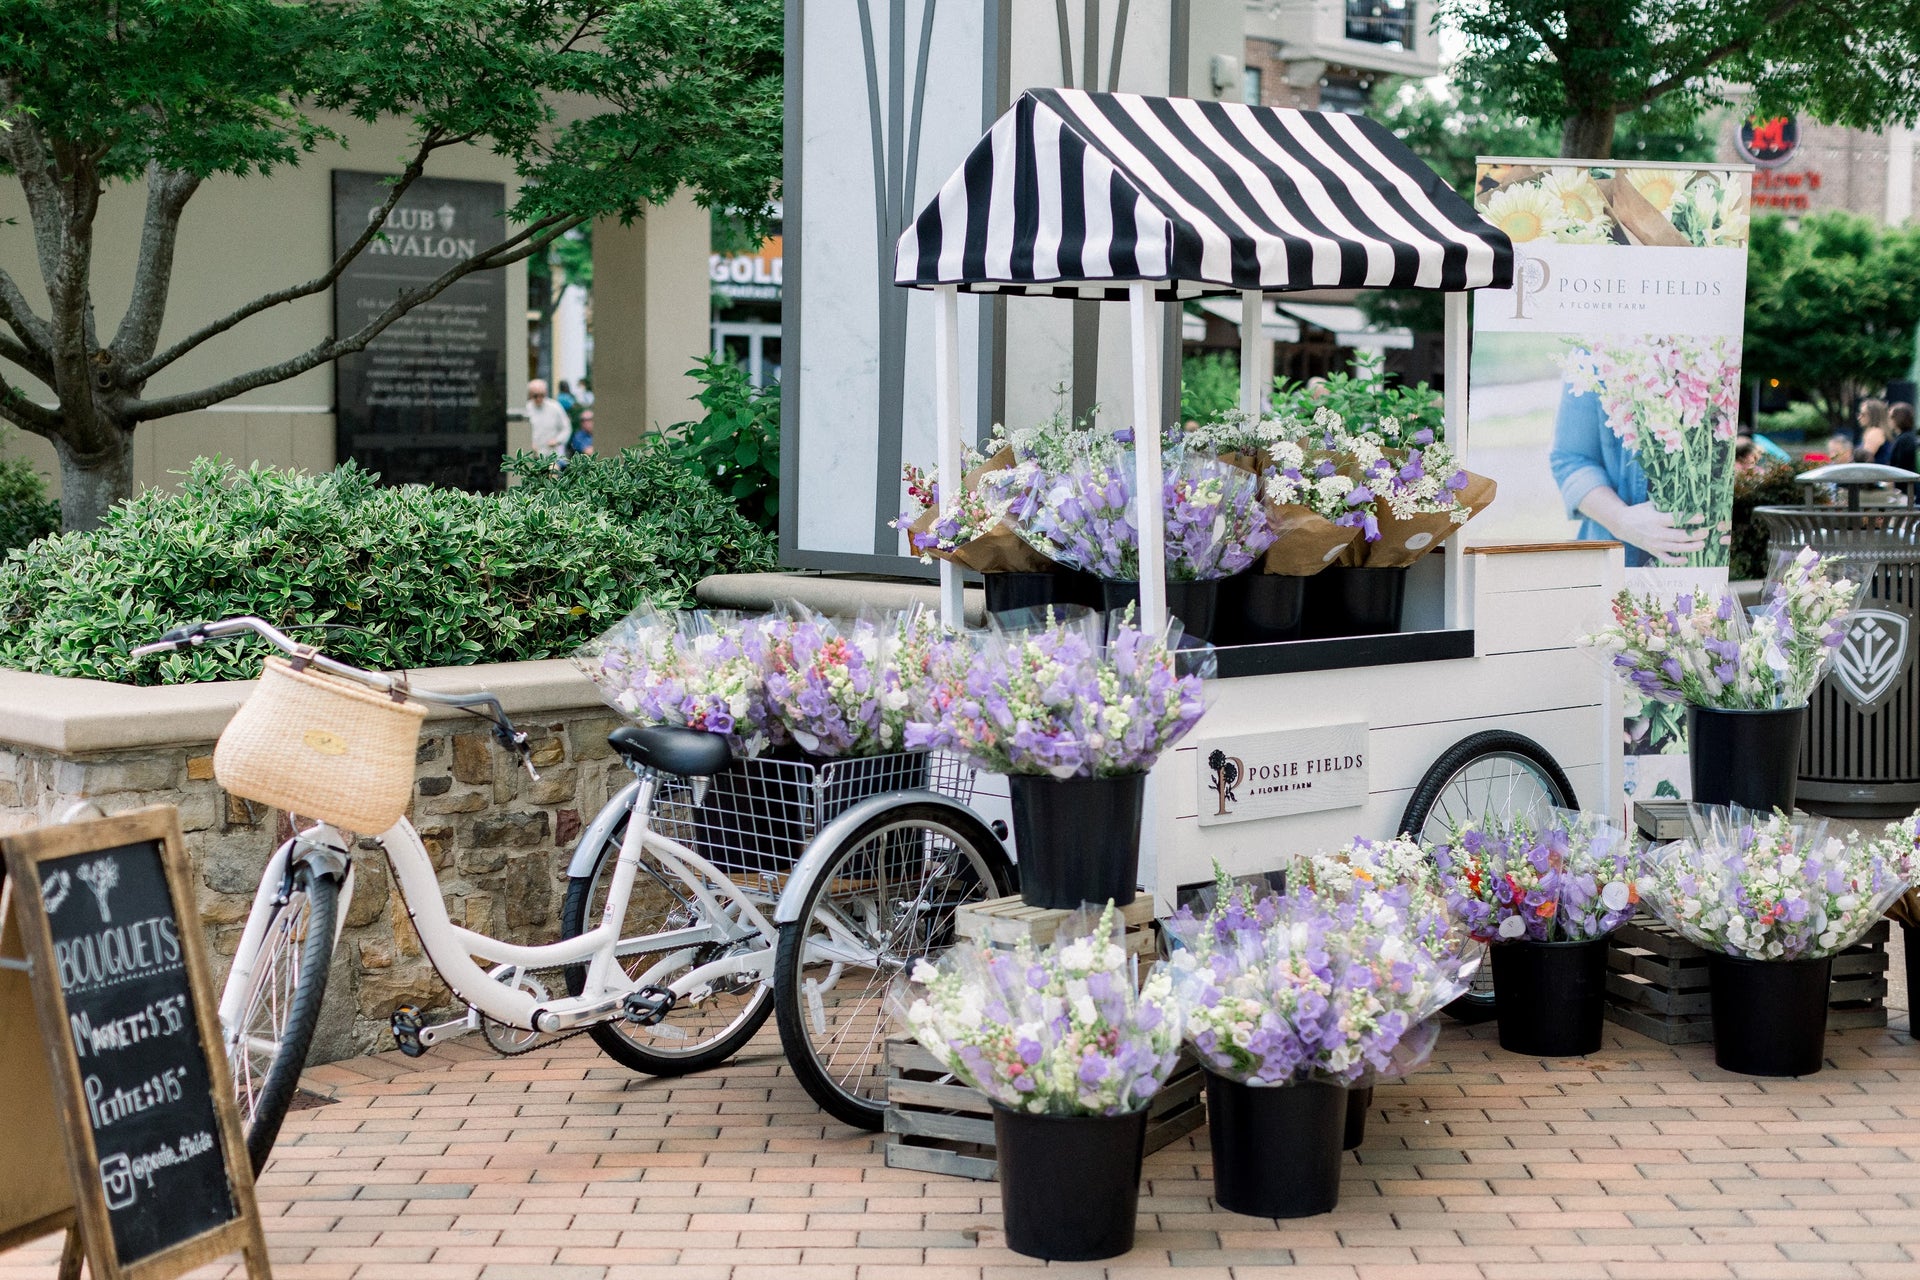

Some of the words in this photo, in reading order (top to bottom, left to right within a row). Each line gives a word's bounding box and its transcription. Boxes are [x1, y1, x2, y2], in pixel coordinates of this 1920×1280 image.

[369, 233, 476, 259] AVALON
[1559, 277, 1626, 294] POSIE
[1641, 279, 1721, 296] FIELDS
[1571, 302, 1612, 310] FLOWER
[1248, 761, 1298, 782] POSIE
[1307, 754, 1363, 775] FIELDS
[1258, 784, 1289, 795] FLOWER
[1292, 781, 1312, 791] FARM
[54, 915, 180, 988] BOUQUETS
